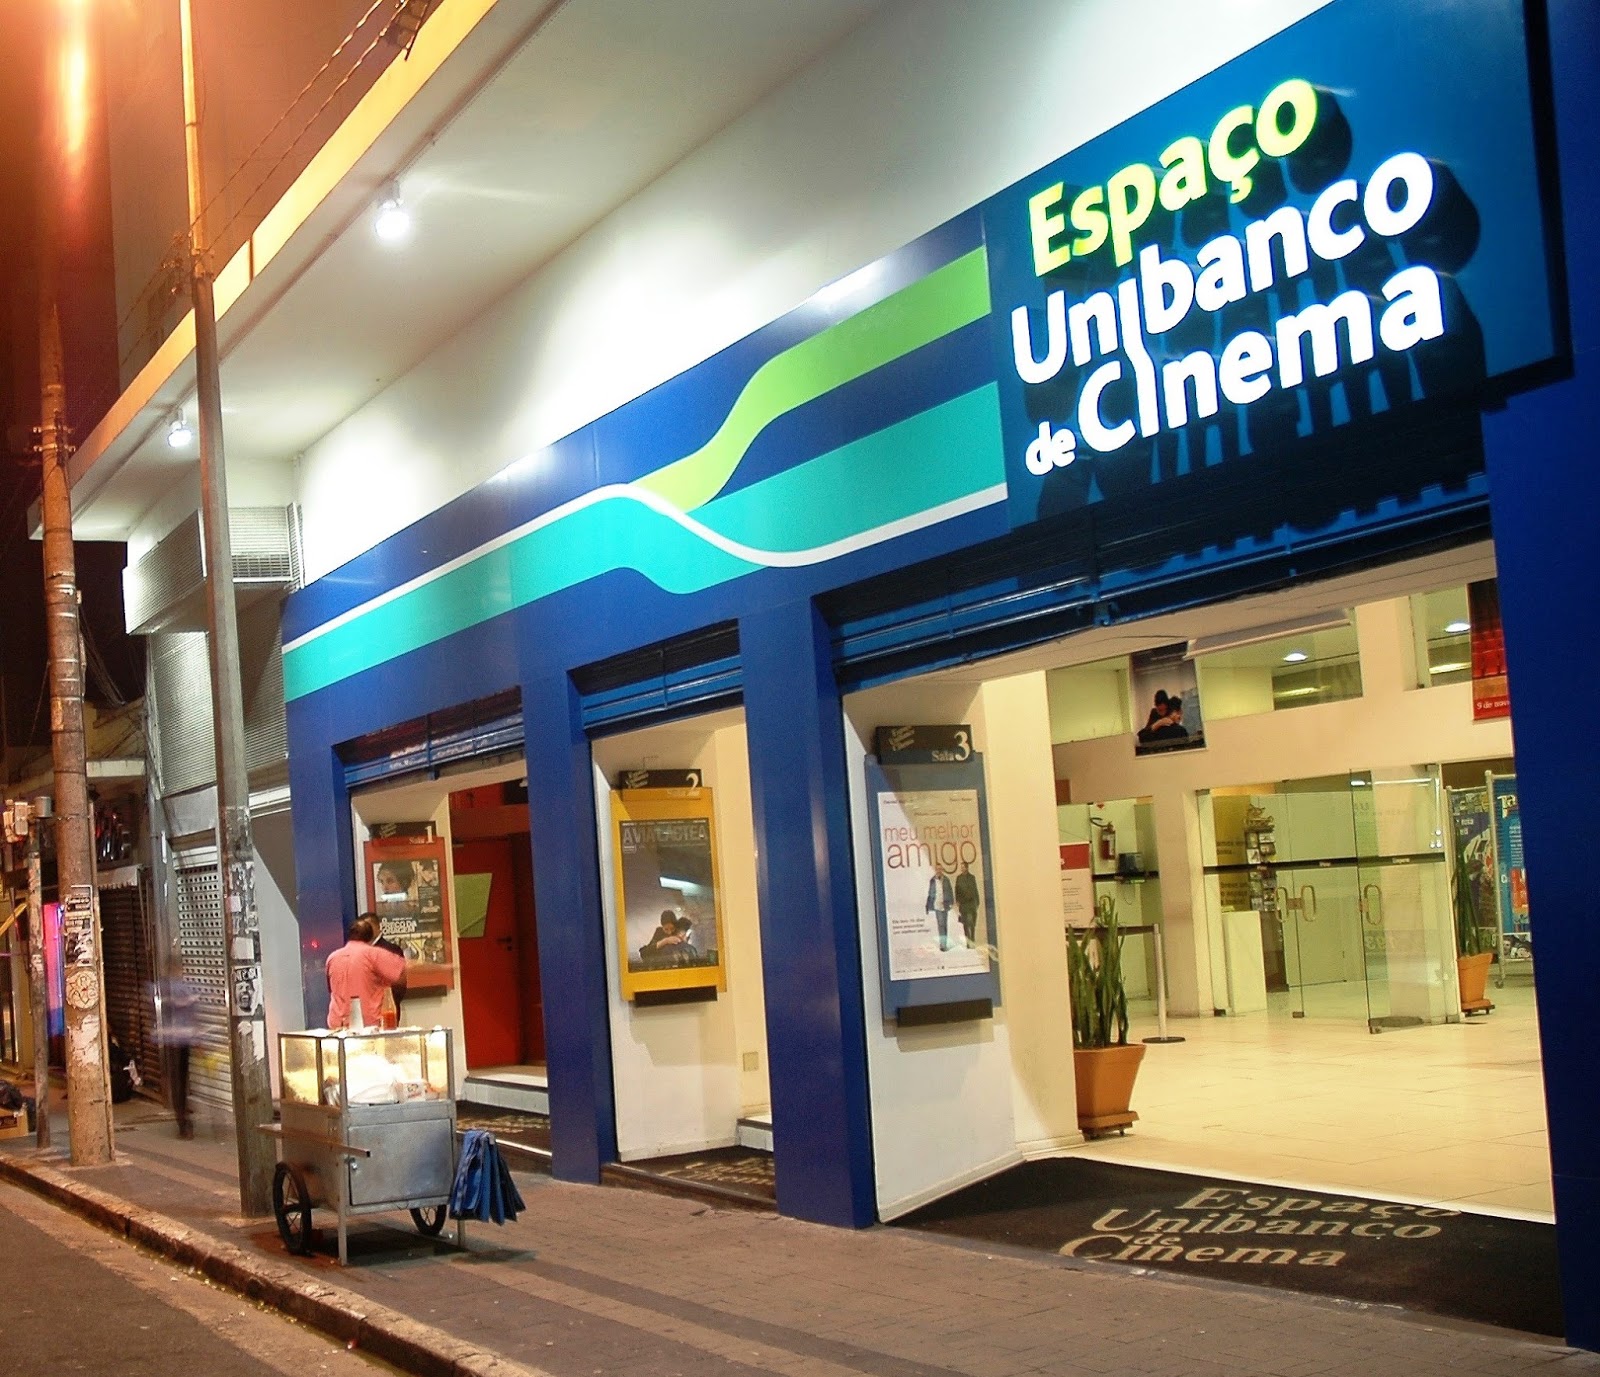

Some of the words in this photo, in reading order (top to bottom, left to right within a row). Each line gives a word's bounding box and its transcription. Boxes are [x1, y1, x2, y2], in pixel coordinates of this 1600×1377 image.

[1028, 79, 1319, 277] Espaço
[1011, 152, 1434, 385] Unibanco
[1025, 421, 1077, 476] de
[1077, 265, 1444, 453] Cinema
[954, 731, 971, 761] 3
[686, 773, 701, 797] 2
[425, 825, 434, 845] 1
[884, 826, 918, 842] meu
[923, 821, 975, 841] melhor
[887, 841, 977, 875] amigo
[1174, 1187, 1462, 1219] Espaço
[1091, 1208, 1442, 1239] Unibanco
[1058, 1234, 1347, 1267] Cinema
[1134, 1233, 1182, 1246] de
